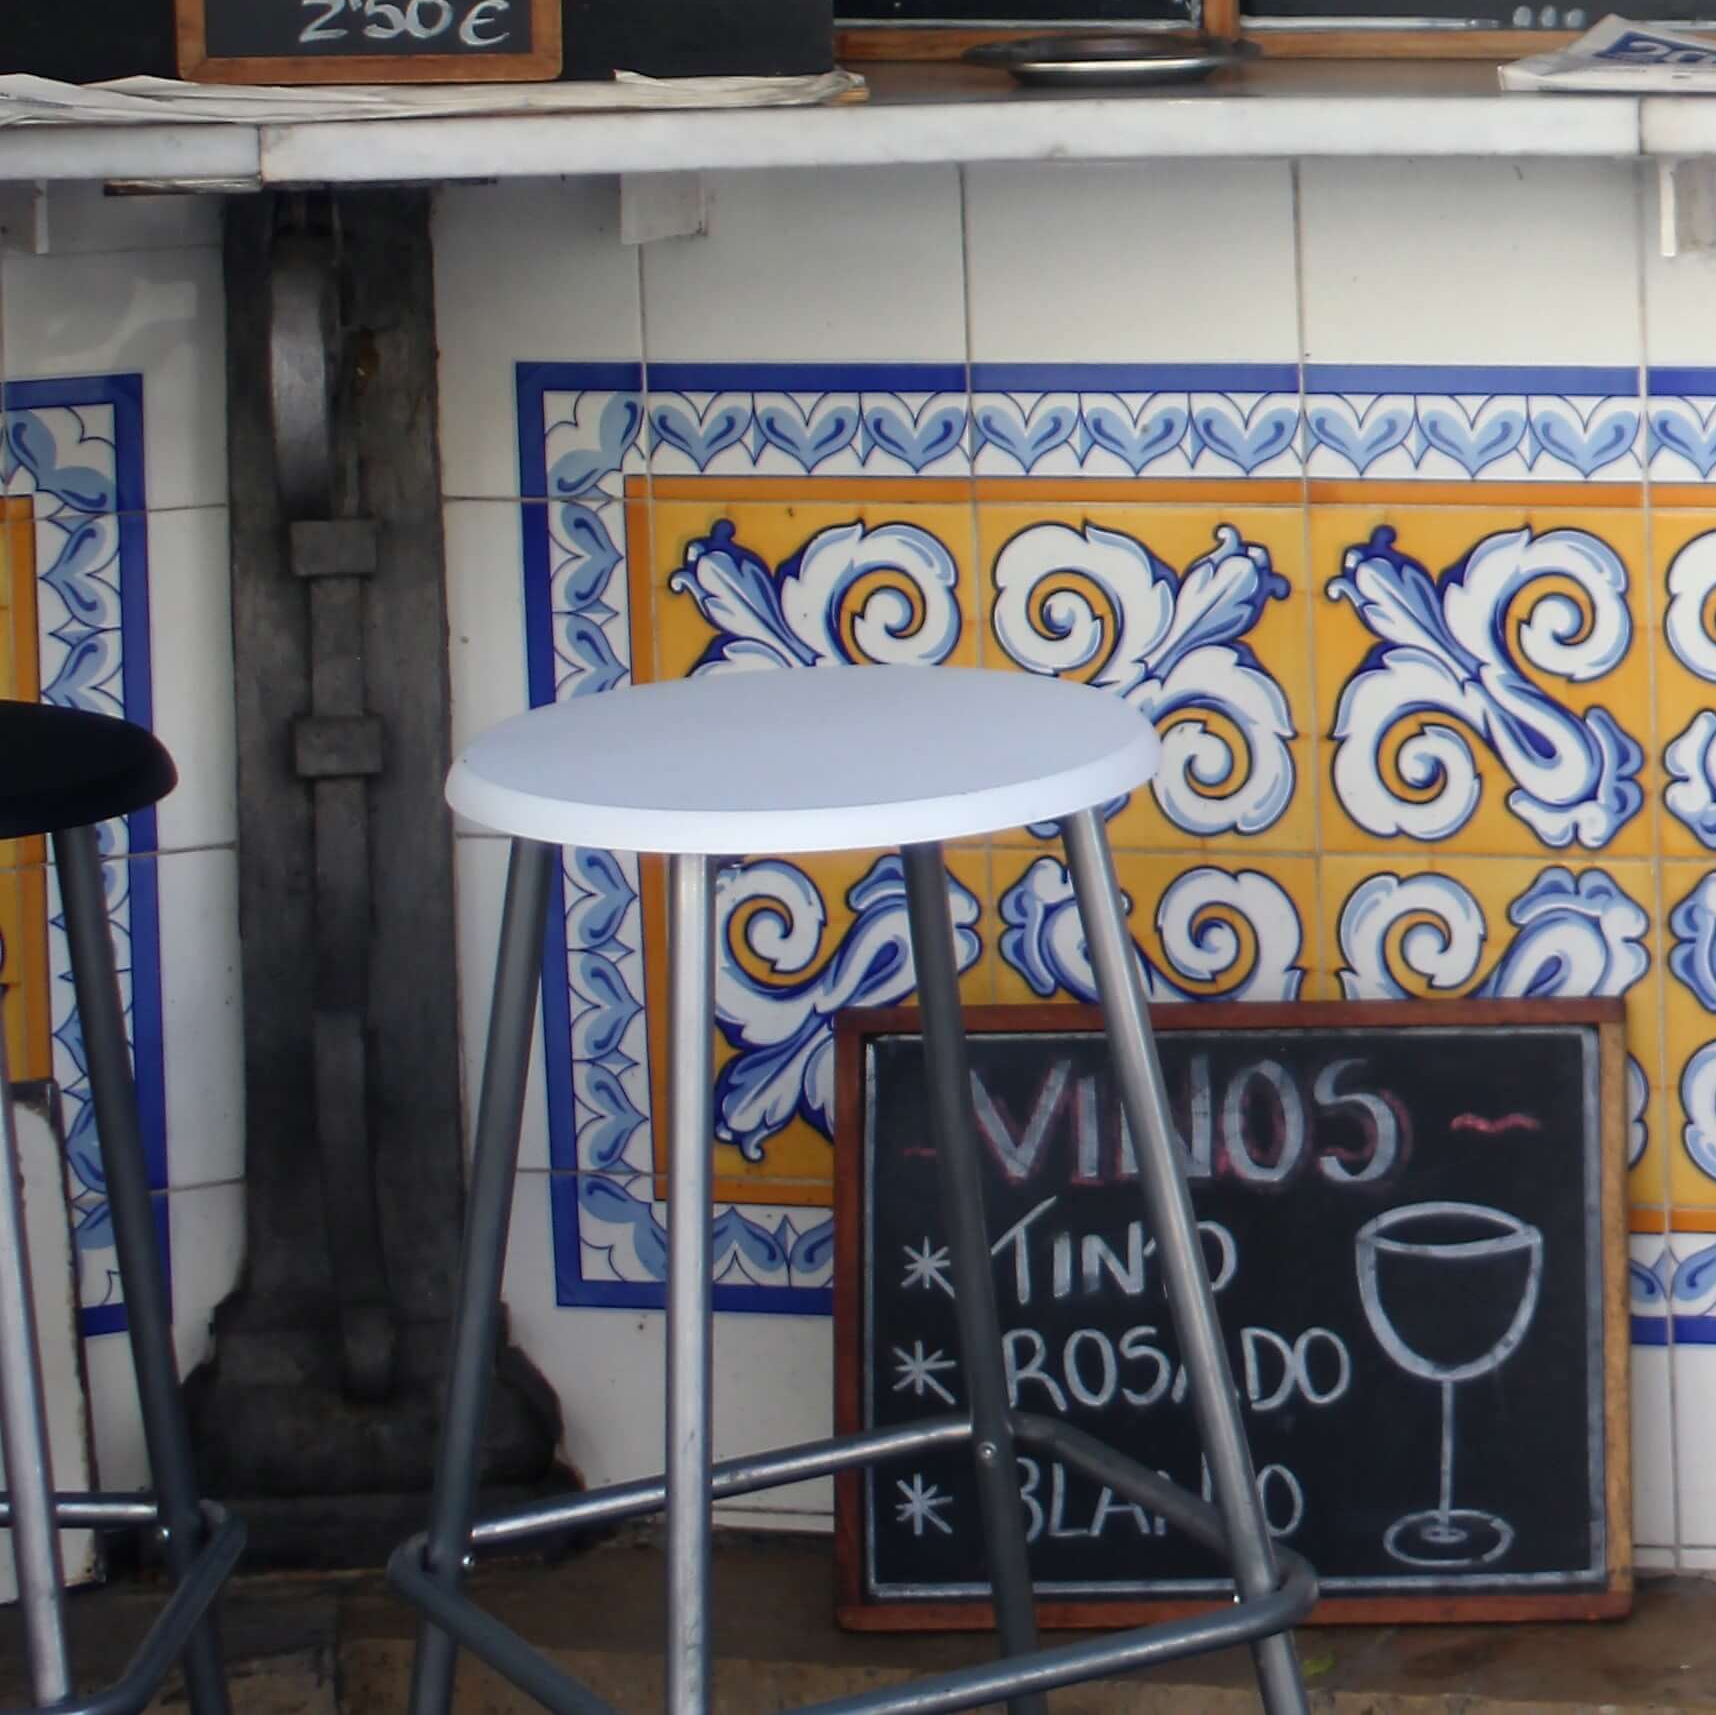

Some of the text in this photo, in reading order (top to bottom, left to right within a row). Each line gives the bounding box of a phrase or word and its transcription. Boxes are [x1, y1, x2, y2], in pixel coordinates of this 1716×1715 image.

[990, 1195, 1239, 1306] TINO
[1001, 1324, 1352, 1413] ROSDO
[1015, 1456, 1304, 1544] BLAO
